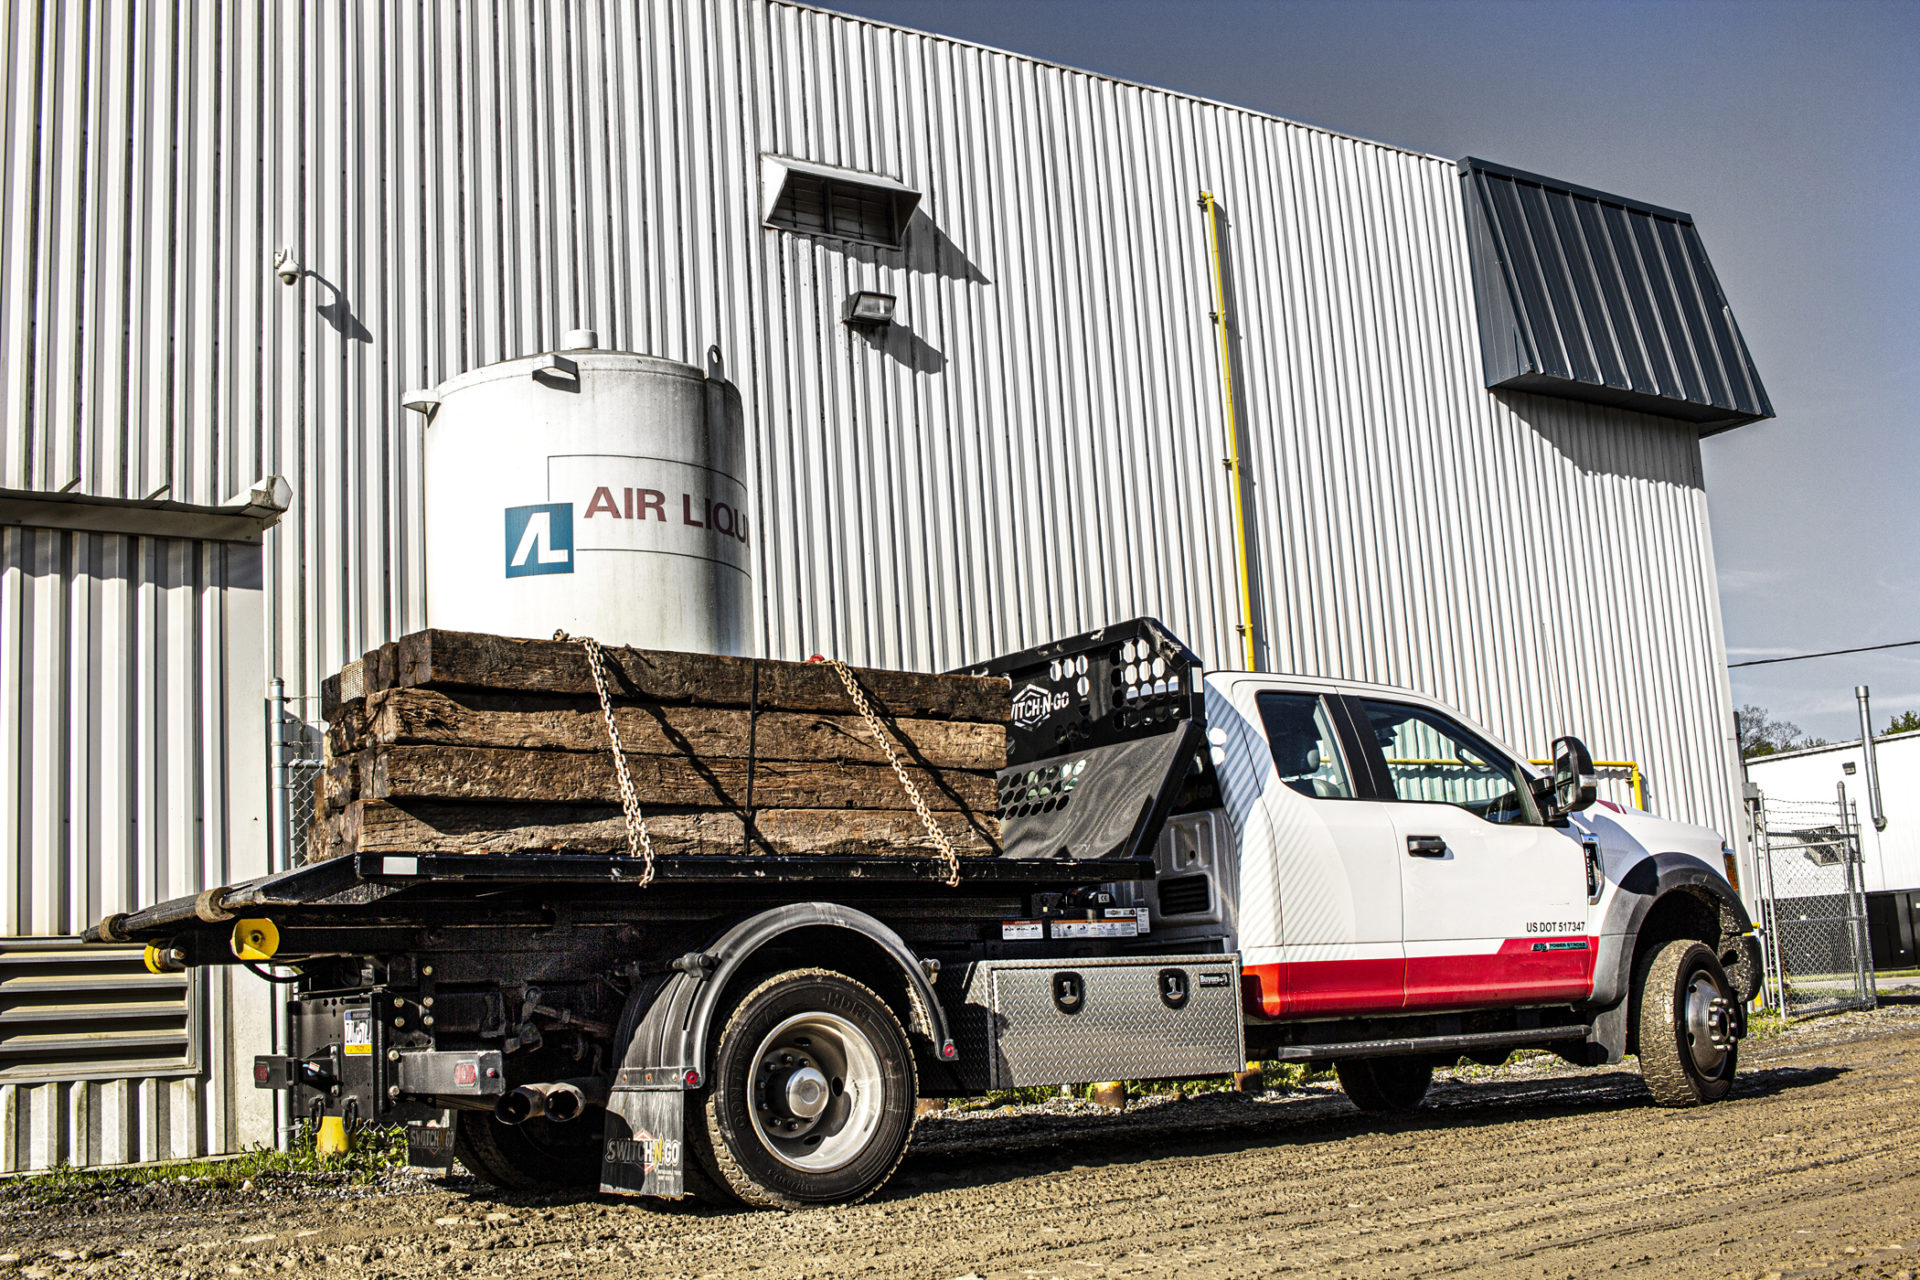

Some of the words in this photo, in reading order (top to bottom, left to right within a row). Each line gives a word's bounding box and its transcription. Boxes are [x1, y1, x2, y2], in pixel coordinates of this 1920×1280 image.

[584, 486, 667, 522] AIR
[1010, 691, 1069, 720] ITCH-N-GO
[1526, 922, 1538, 932] US
[1540, 922, 1557, 932] DOT
[1558, 921, 1585, 931] 517347
